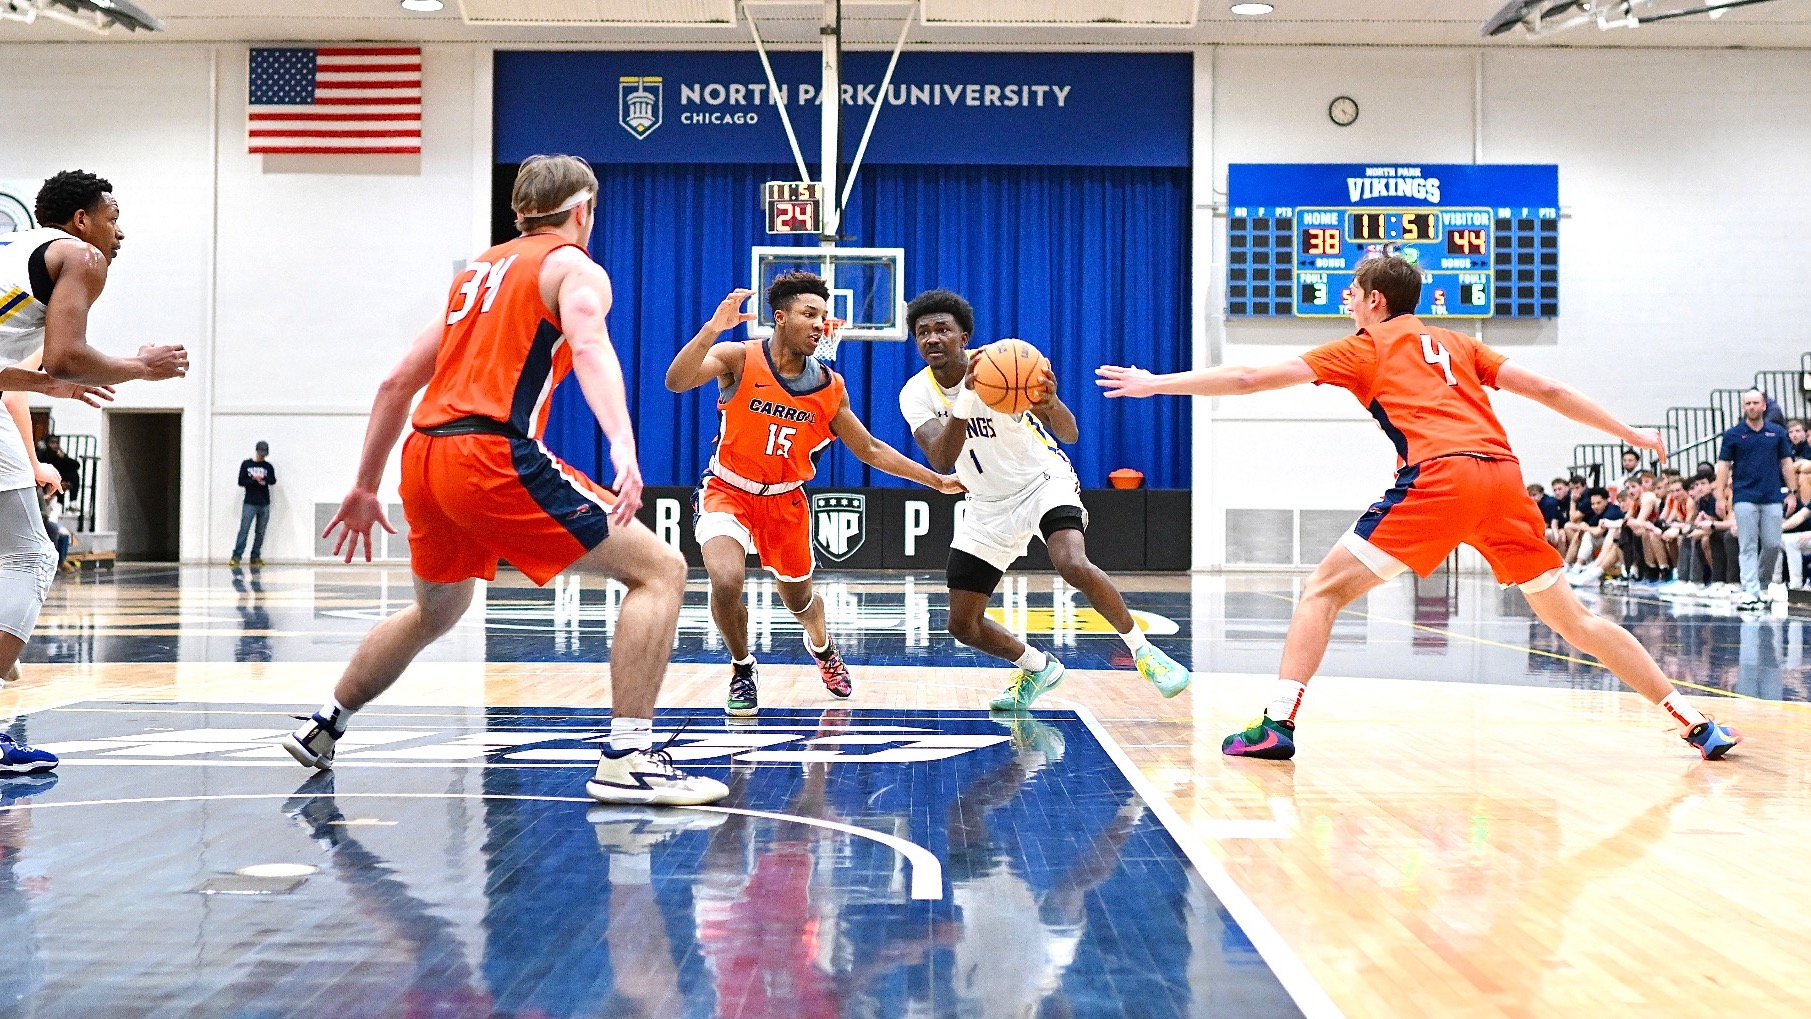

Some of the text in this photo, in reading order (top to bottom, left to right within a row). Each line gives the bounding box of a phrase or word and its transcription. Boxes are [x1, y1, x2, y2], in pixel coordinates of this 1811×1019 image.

[681, 83, 788, 105] NORTH
[886, 84, 1072, 106] UNIVERSITY
[680, 112, 758, 124] CHICAGO
[1365, 167, 1422, 177] NORTH PARK
[1347, 177, 1441, 204] VIKINGS
[776, 203, 812, 231] 24
[1303, 212, 1339, 225] HOME
[1362, 213, 1434, 239] 11:51
[1443, 212, 1489, 226] VISITOR
[1308, 229, 1340, 254] 38
[1453, 229, 1487, 255] 44
[1315, 258, 1346, 268] BONUS
[1441, 258, 1471, 268] BONUS
[446, 253, 520, 325] 34
[1301, 273, 1328, 283] FOULS
[1458, 274, 1487, 284] FOULS
[1313, 283, 1327, 305] 3
[1434, 289, 1445, 305] 5
[1471, 283, 1486, 306] 6
[1419, 333, 1458, 387] 4
[966, 416, 997, 438] NGS
[764, 423, 797, 459] 15
[969, 448, 984, 475] 1
[817, 511, 860, 555] NP
